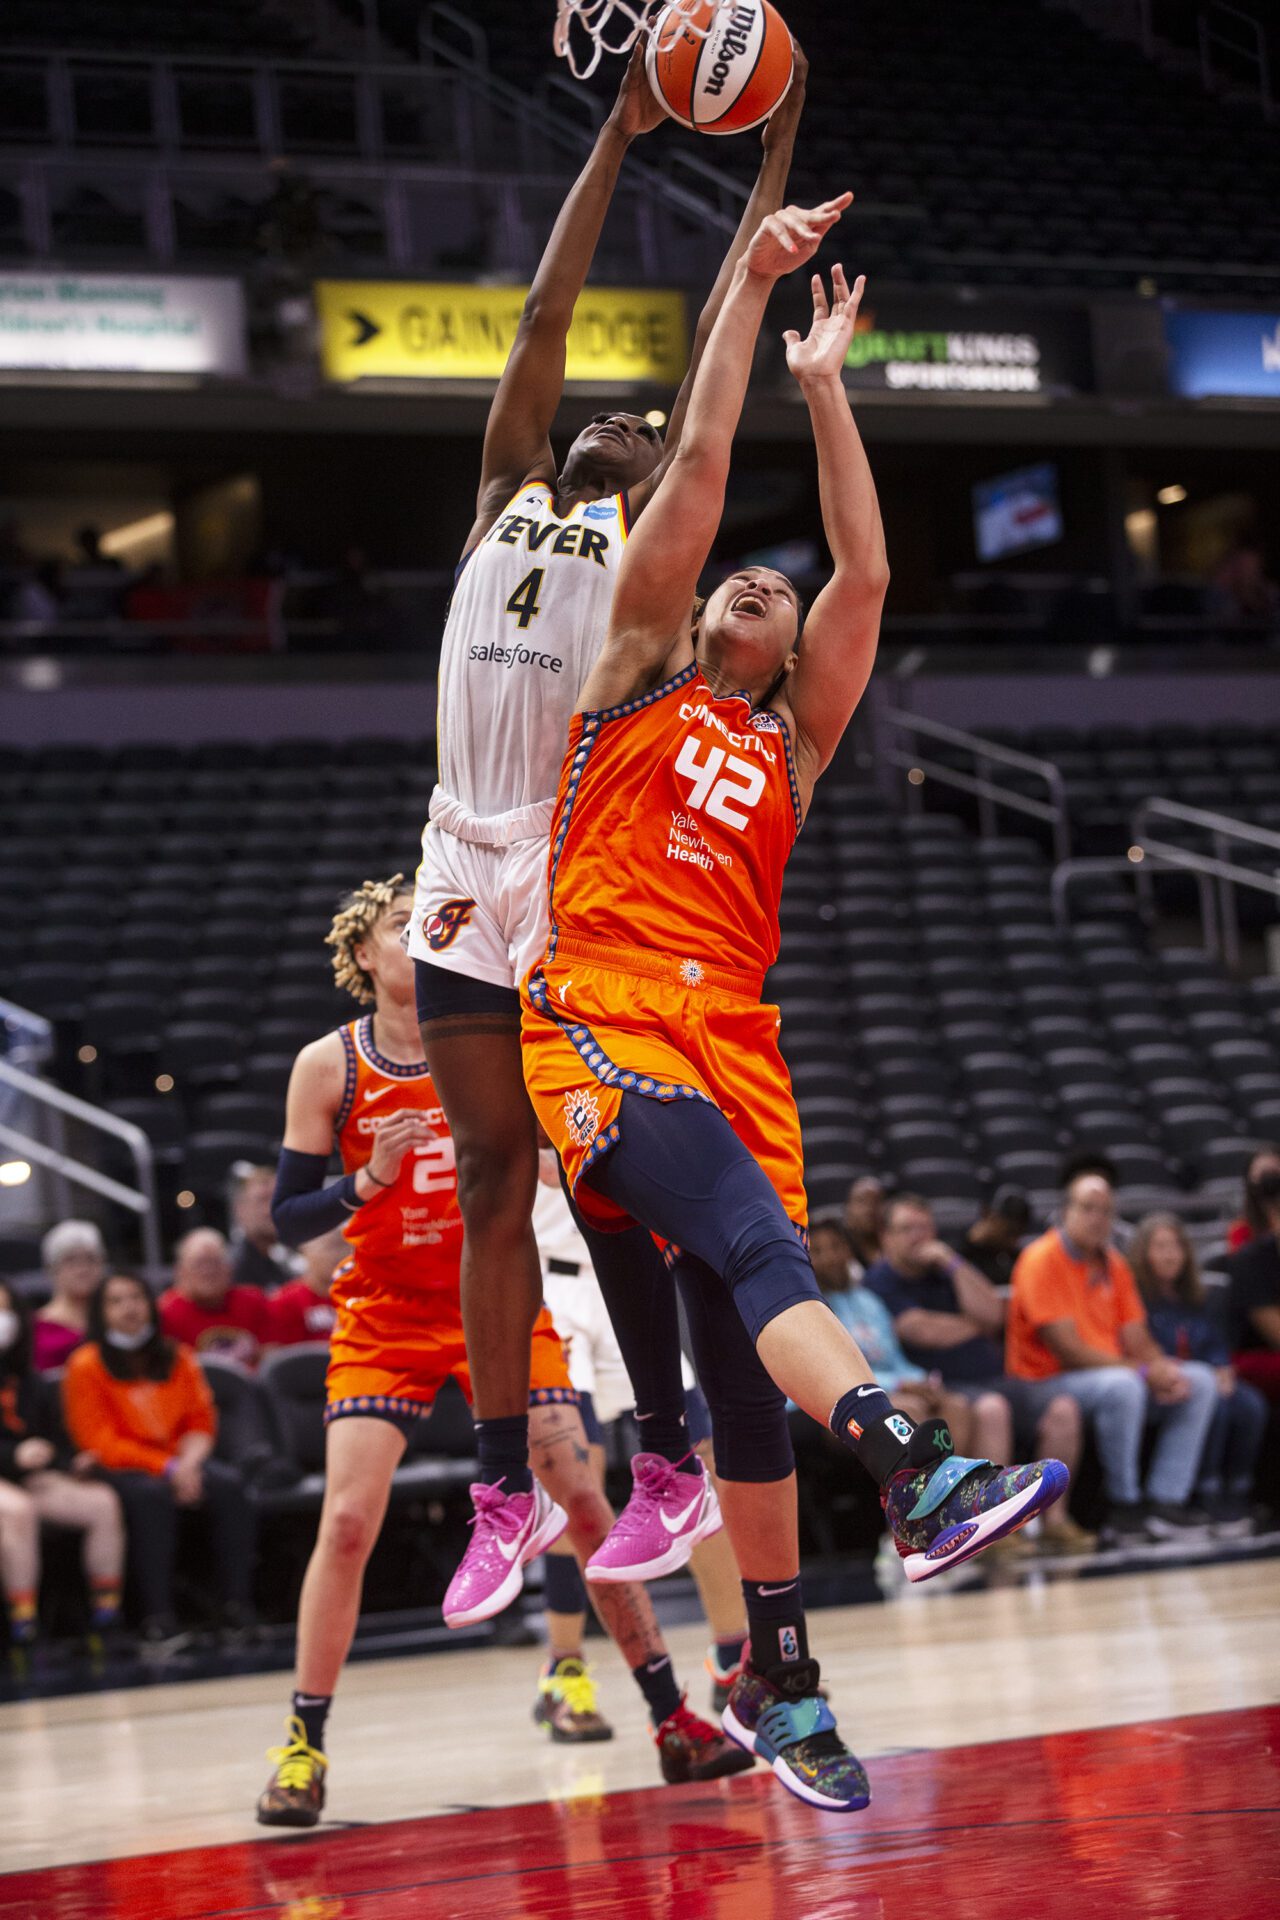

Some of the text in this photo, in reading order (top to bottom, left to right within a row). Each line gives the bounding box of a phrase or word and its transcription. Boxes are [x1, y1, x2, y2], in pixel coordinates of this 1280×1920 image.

[703, 4, 756, 97] Wilson
[401, 304, 669, 364] GAINIDGE
[486, 514, 609, 569] FEVER
[506, 567, 545, 630] 4
[468, 642, 563, 674] salesforce
[674, 735, 767, 832] 42
[671, 810, 698, 831] Yale
[666, 843, 714, 871] Health
